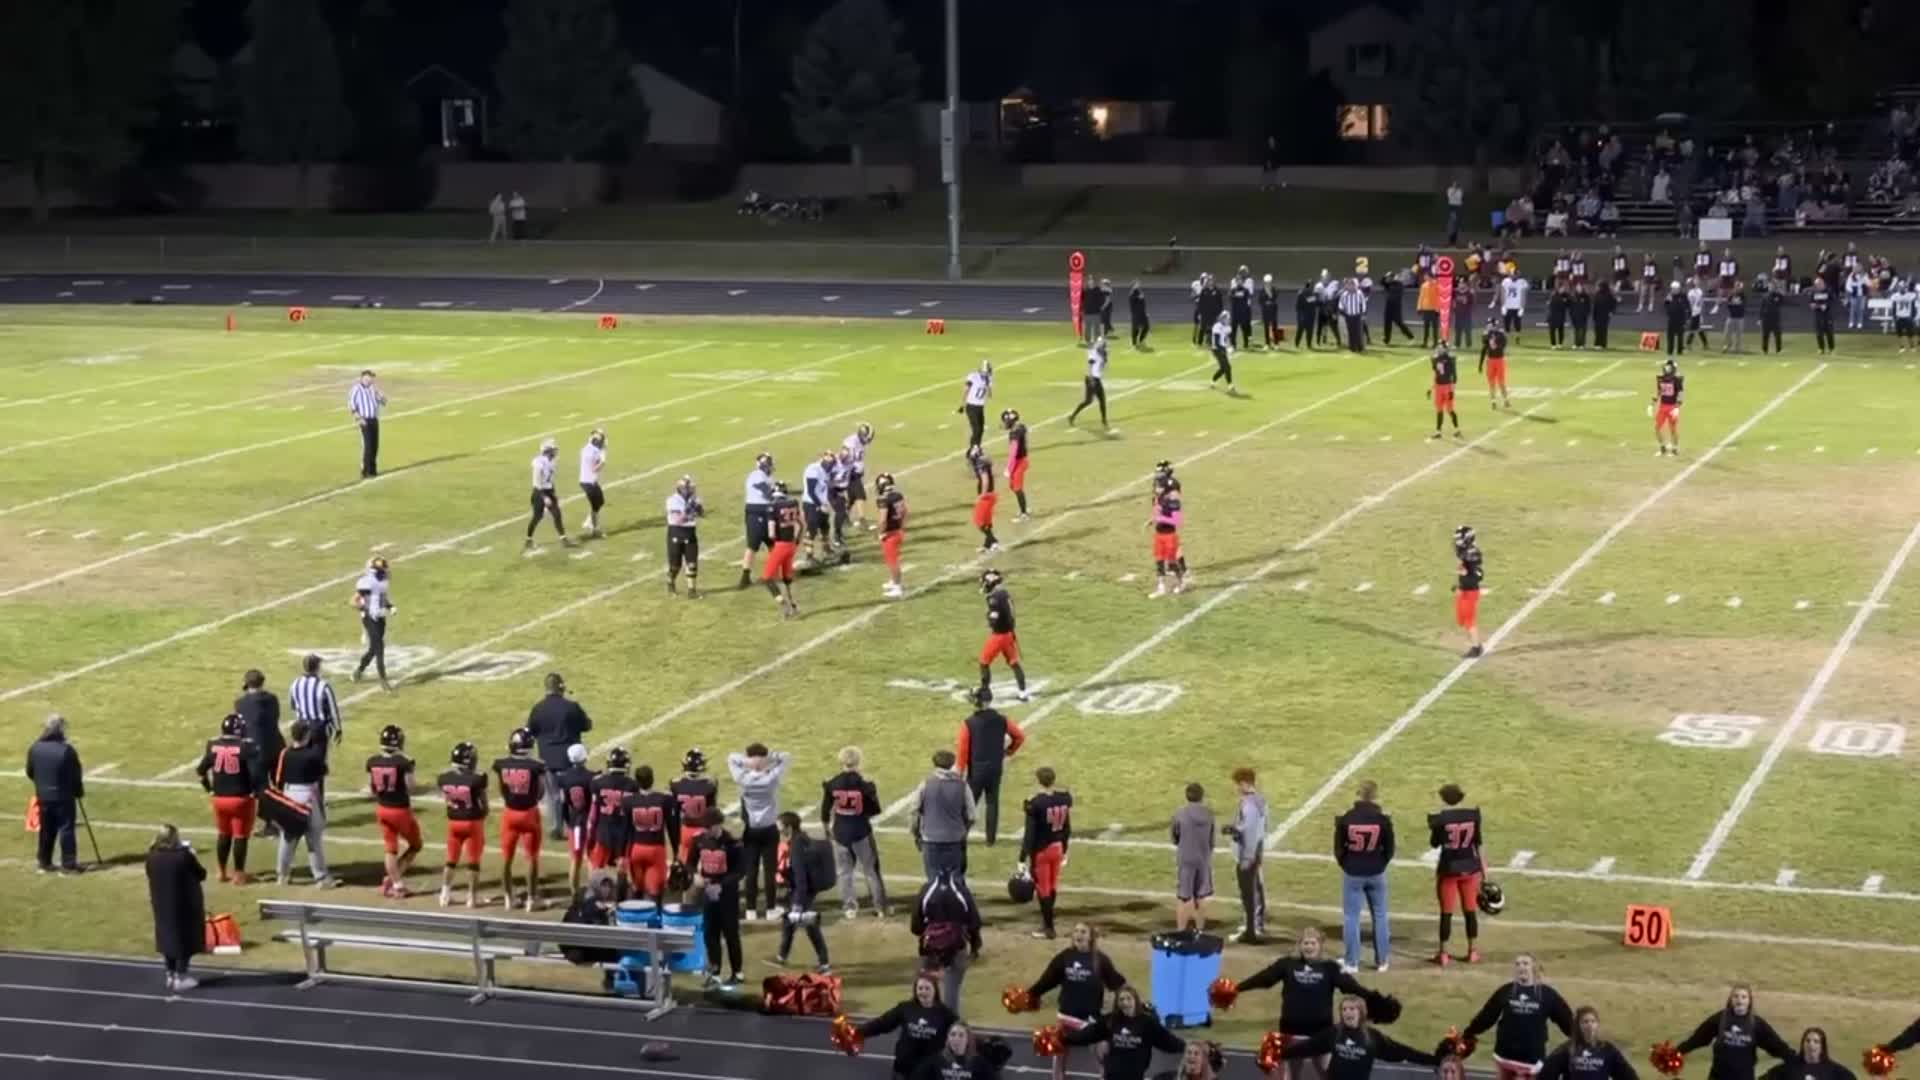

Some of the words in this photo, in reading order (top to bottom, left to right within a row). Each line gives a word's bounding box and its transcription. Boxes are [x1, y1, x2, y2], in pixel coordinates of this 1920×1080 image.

[1355, 256, 1369, 273] 2
[1656, 713, 1905, 757] 50
[1348, 824, 1381, 851] 57
[1445, 821, 1476, 849] 37
[1629, 909, 1662, 945] 50
